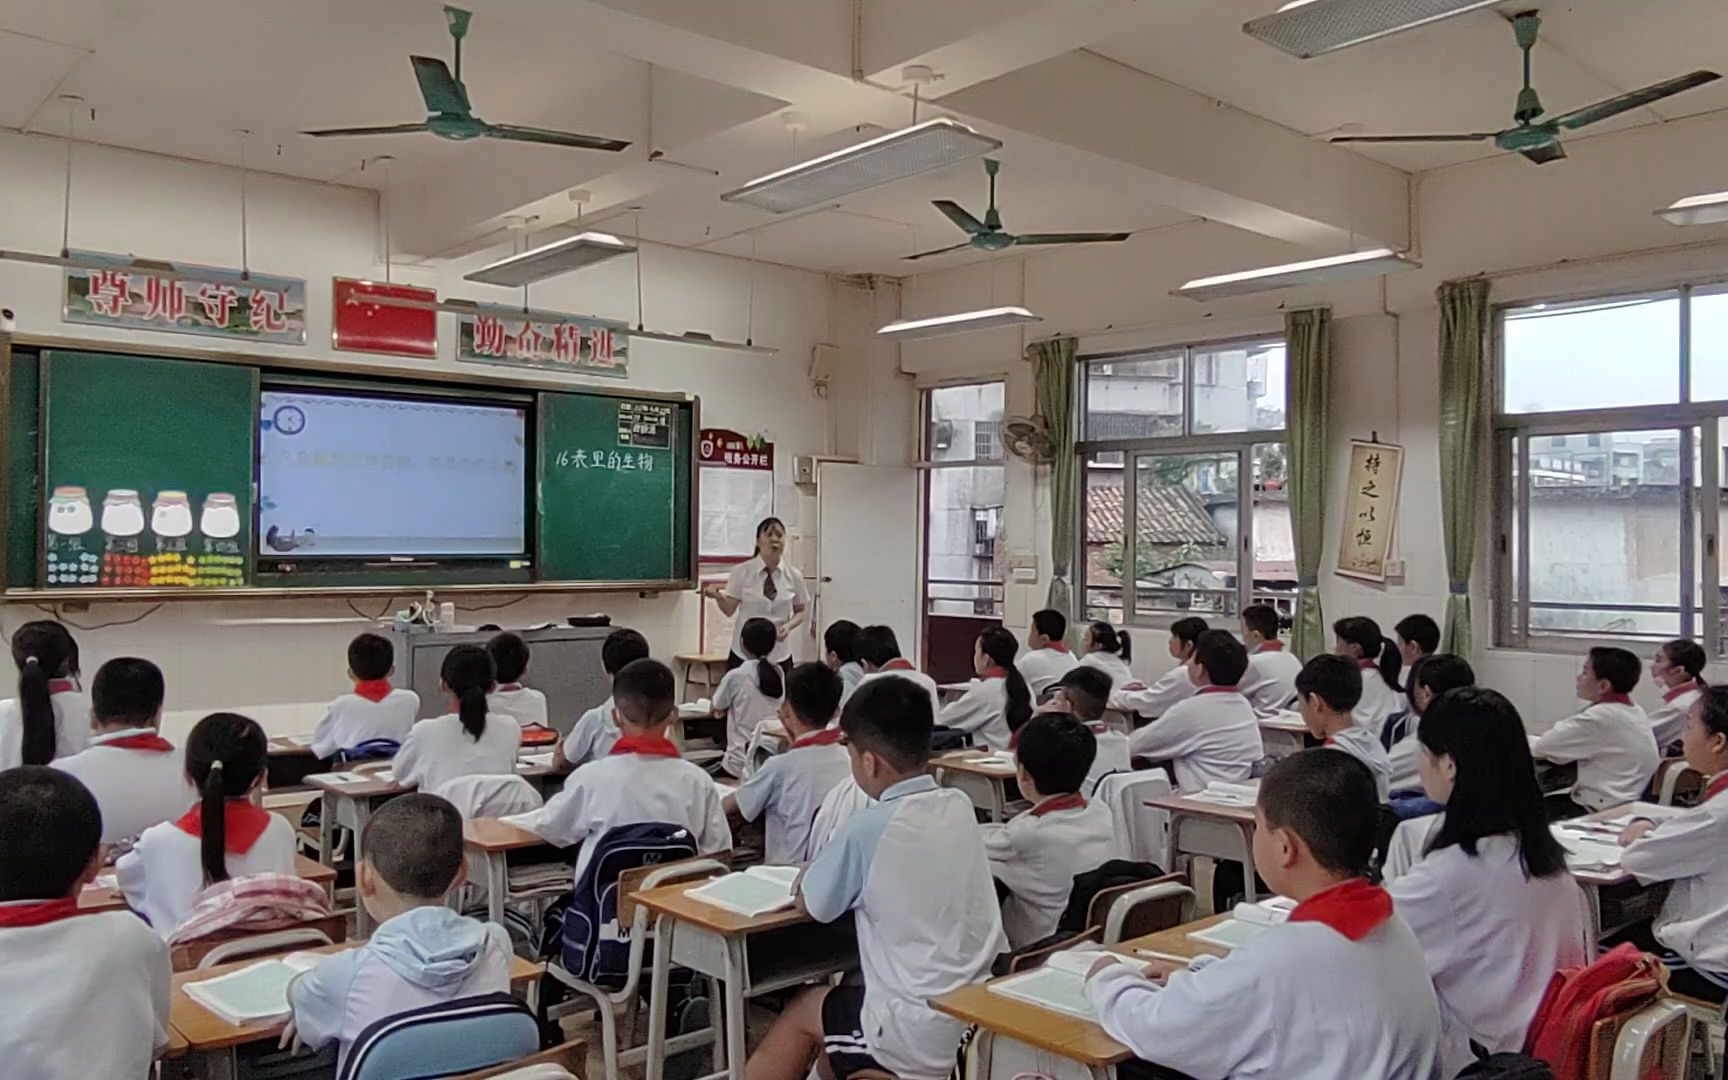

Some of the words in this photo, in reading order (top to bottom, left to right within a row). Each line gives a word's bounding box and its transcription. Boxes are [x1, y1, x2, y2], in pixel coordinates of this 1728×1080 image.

[87, 268, 288, 333] 尊师守纪
[555, 448, 654, 472] 16表里的生物
[1355, 452, 1382, 546] 持之以恒
